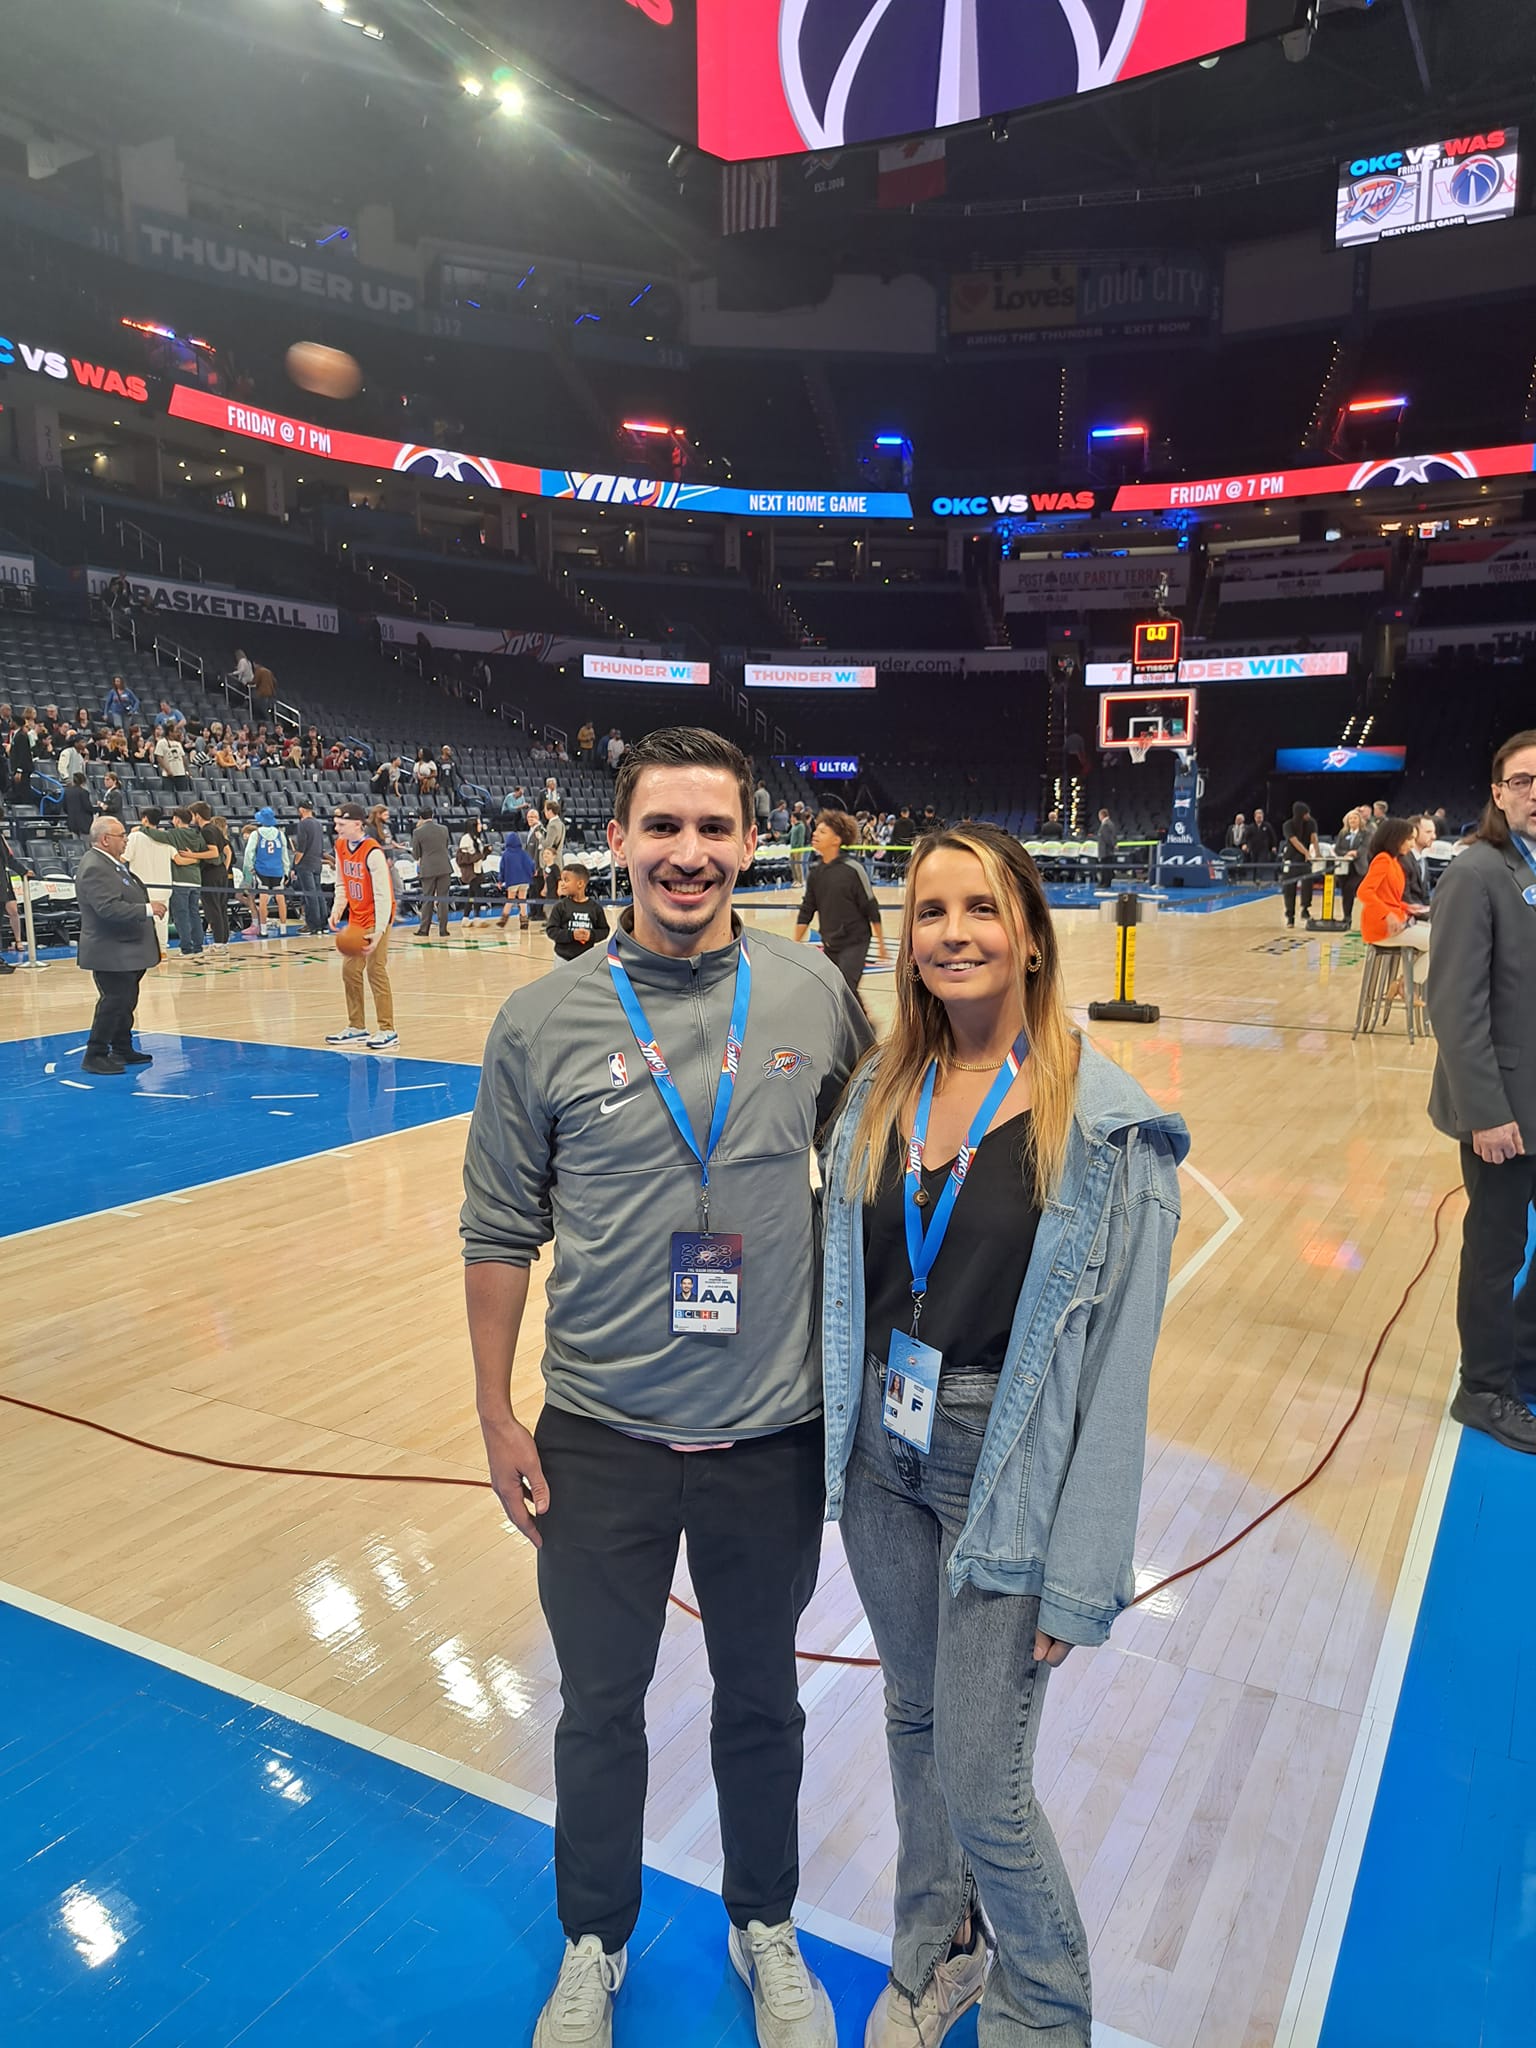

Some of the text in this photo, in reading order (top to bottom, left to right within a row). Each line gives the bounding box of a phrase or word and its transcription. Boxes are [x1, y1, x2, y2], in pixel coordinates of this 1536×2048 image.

[1350, 152, 1402, 176] OKC
[1405, 145, 1441, 164] VS
[1444, 130, 1505, 156] WAS
[1381, 215, 1465, 237] NEXT HOME GAME
[140, 224, 414, 315] THUNDER UP
[17, 343, 68, 379] VS
[71, 359, 148, 402] WAS
[228, 405, 331, 453] FRIDAY @ 7 PM
[1170, 476, 1284, 504] FRIDAY @ 7 PM
[749, 494, 867, 513] NEXT HOME GAME
[932, 491, 1095, 516] OKC VS WAS
[1019, 568, 1176, 585] POST OAK PARTY TERRAE
[131, 583, 337, 632] BASKETBALL 107
[590, 661, 667, 677] THUNDER
[752, 670, 832, 683] THUNDER
[819, 762, 857, 772] ULTRA
[267, 841, 275, 854] 2
[1167, 834, 1193, 844] Health
[641, 1046, 668, 1070] OKC
[726, 1043, 738, 1075] OKC
[774, 1054, 796, 1070] OKC
[958, 1145, 970, 1177] OKC
[699, 1289, 736, 1304] AA
[911, 1398, 924, 1412] F
